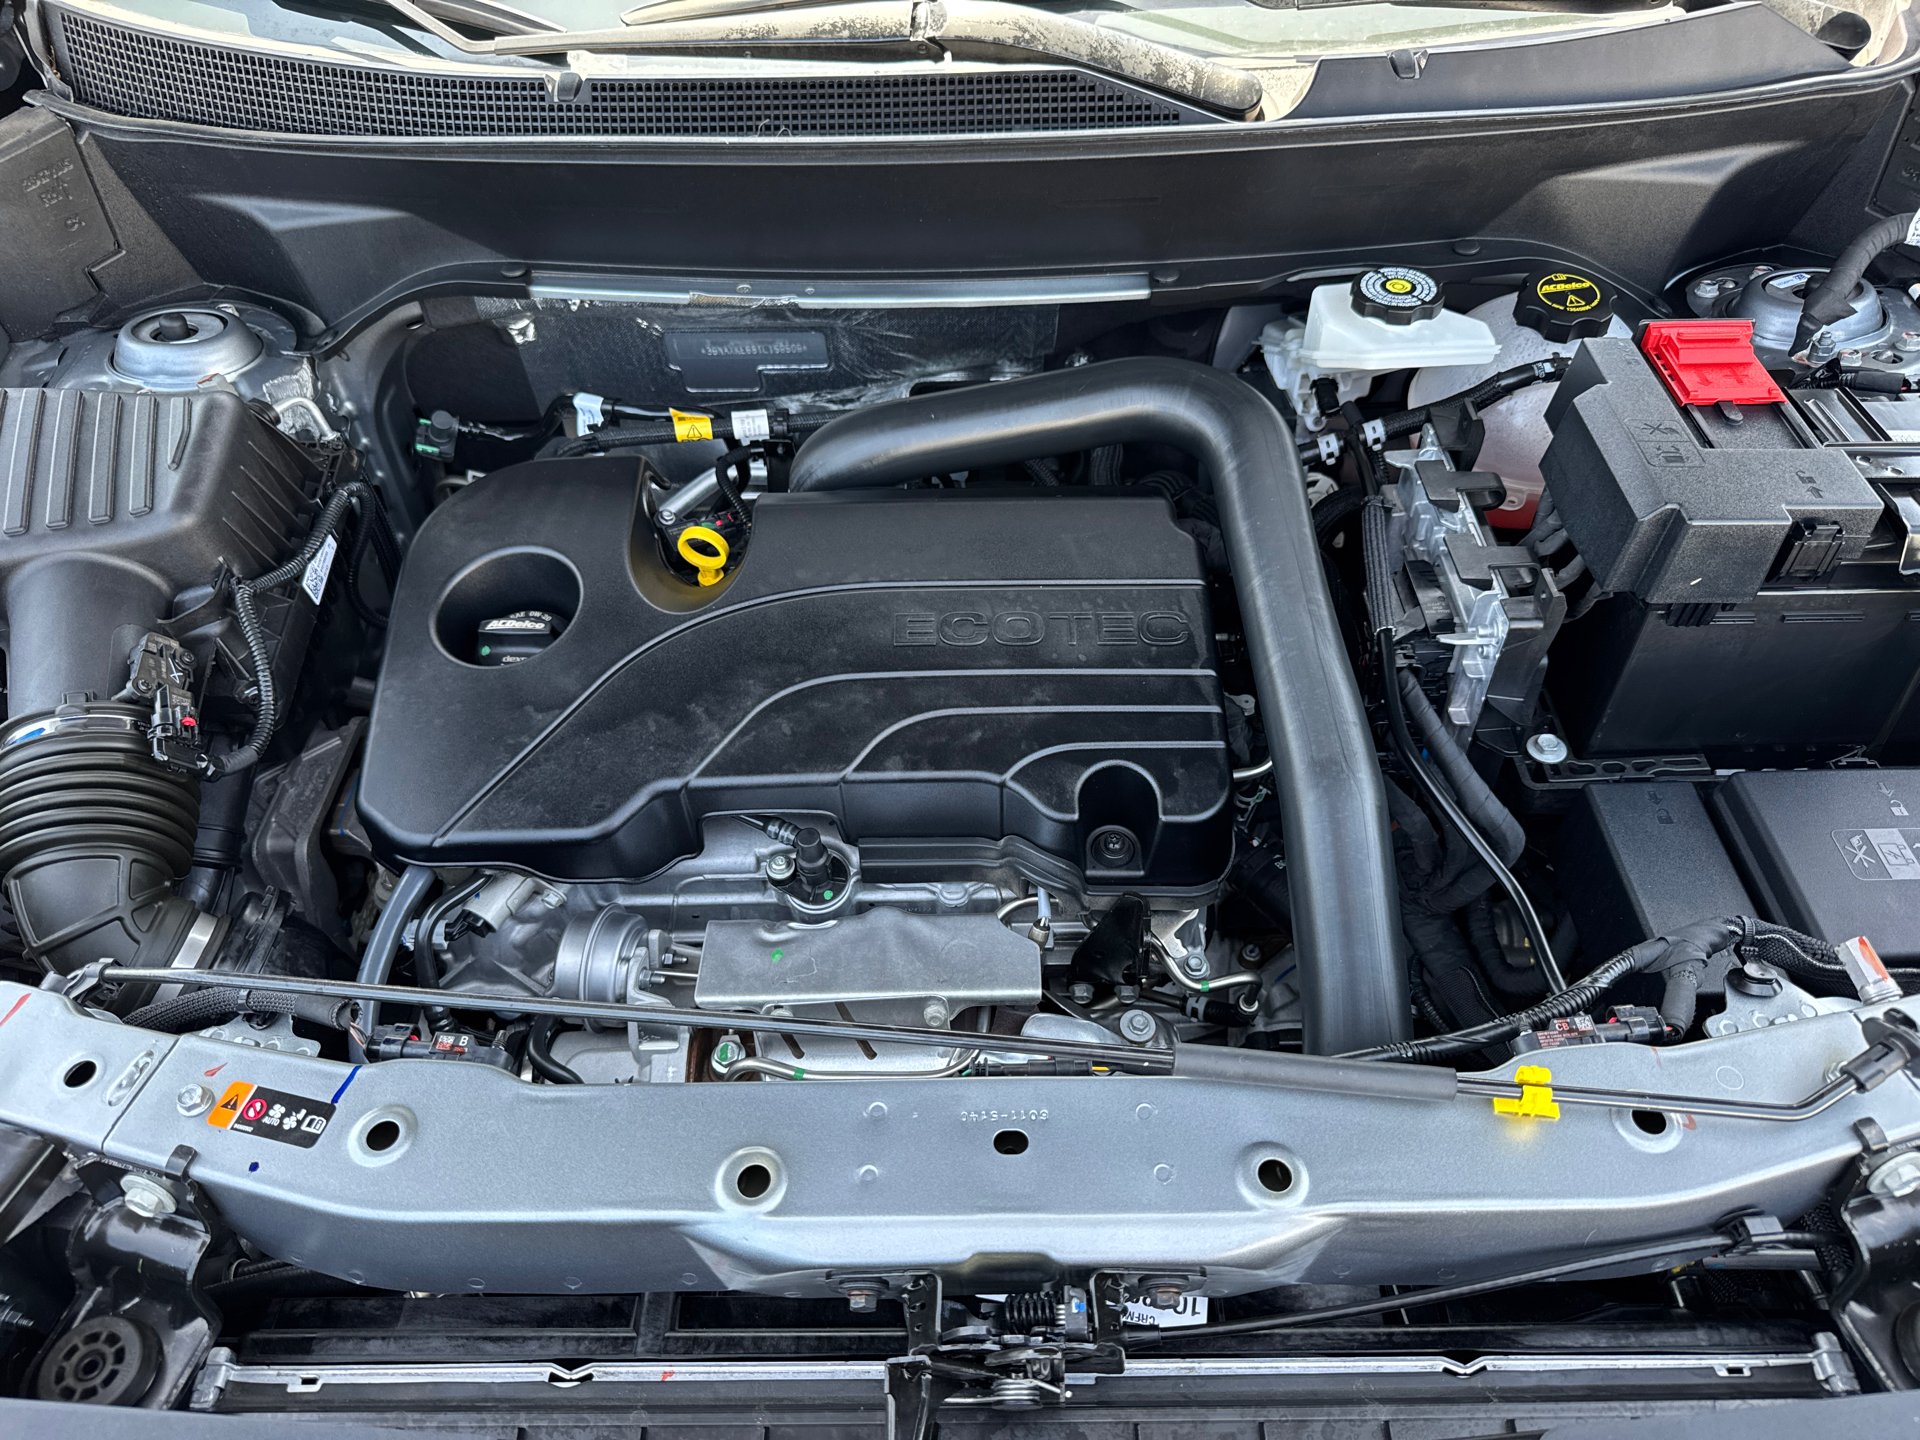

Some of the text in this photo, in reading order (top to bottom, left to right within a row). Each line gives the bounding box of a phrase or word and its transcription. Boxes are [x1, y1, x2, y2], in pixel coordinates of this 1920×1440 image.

[1541, 281, 1591, 293] ACDelco
[485, 620, 546, 630] ACDelco
[893, 610, 1189, 646] ECOTEC
[1555, 1022, 1570, 1032] CB
[459, 1035, 469, 1046] B
[261, 1116, 280, 1127] AUTO
